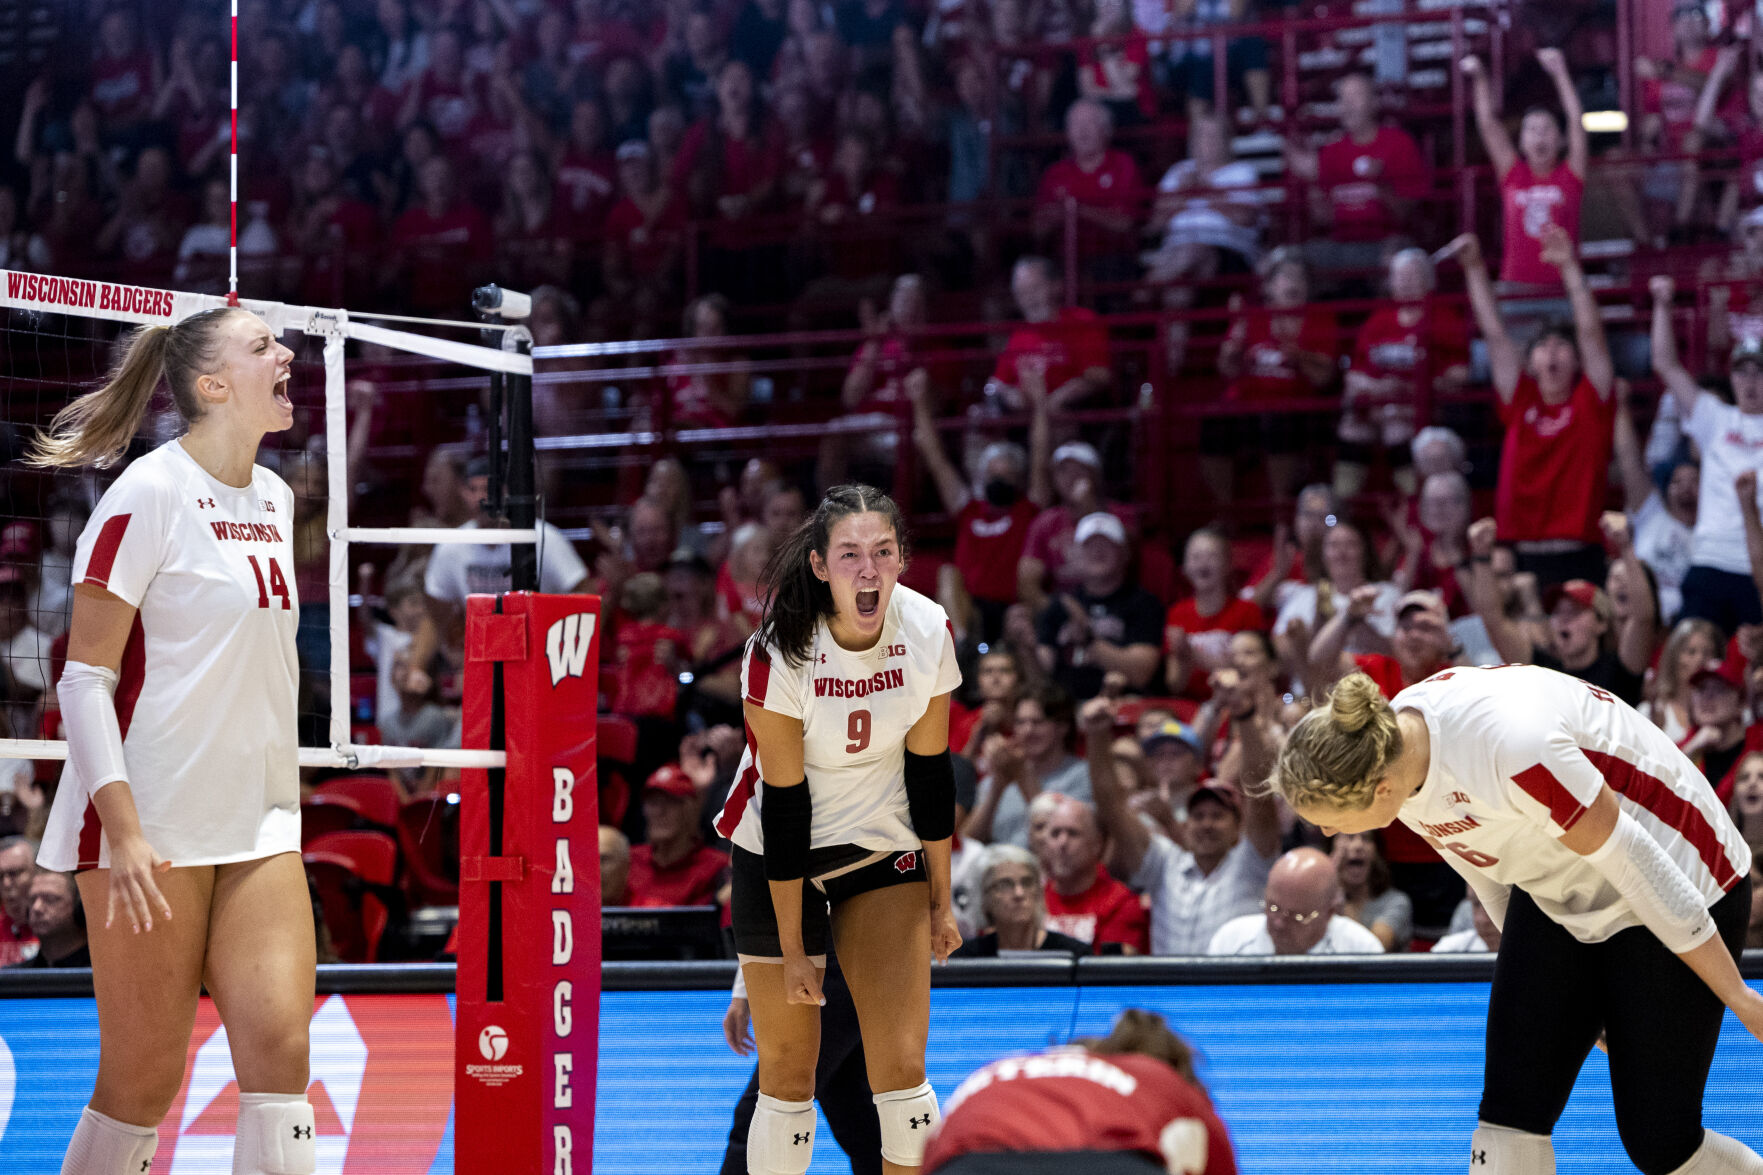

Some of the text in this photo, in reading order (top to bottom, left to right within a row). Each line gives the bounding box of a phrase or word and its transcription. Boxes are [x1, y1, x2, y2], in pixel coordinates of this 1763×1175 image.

[7, 272, 174, 317] WISCONSIN BADGERS
[210, 521, 284, 543] WISCONSIN
[247, 555, 291, 610] 14
[545, 612, 597, 688] W
[814, 668, 904, 698] WISCONSIN
[846, 709, 872, 754] 9
[1445, 841, 1500, 868] 6
[551, 766, 575, 1175] BADGER
